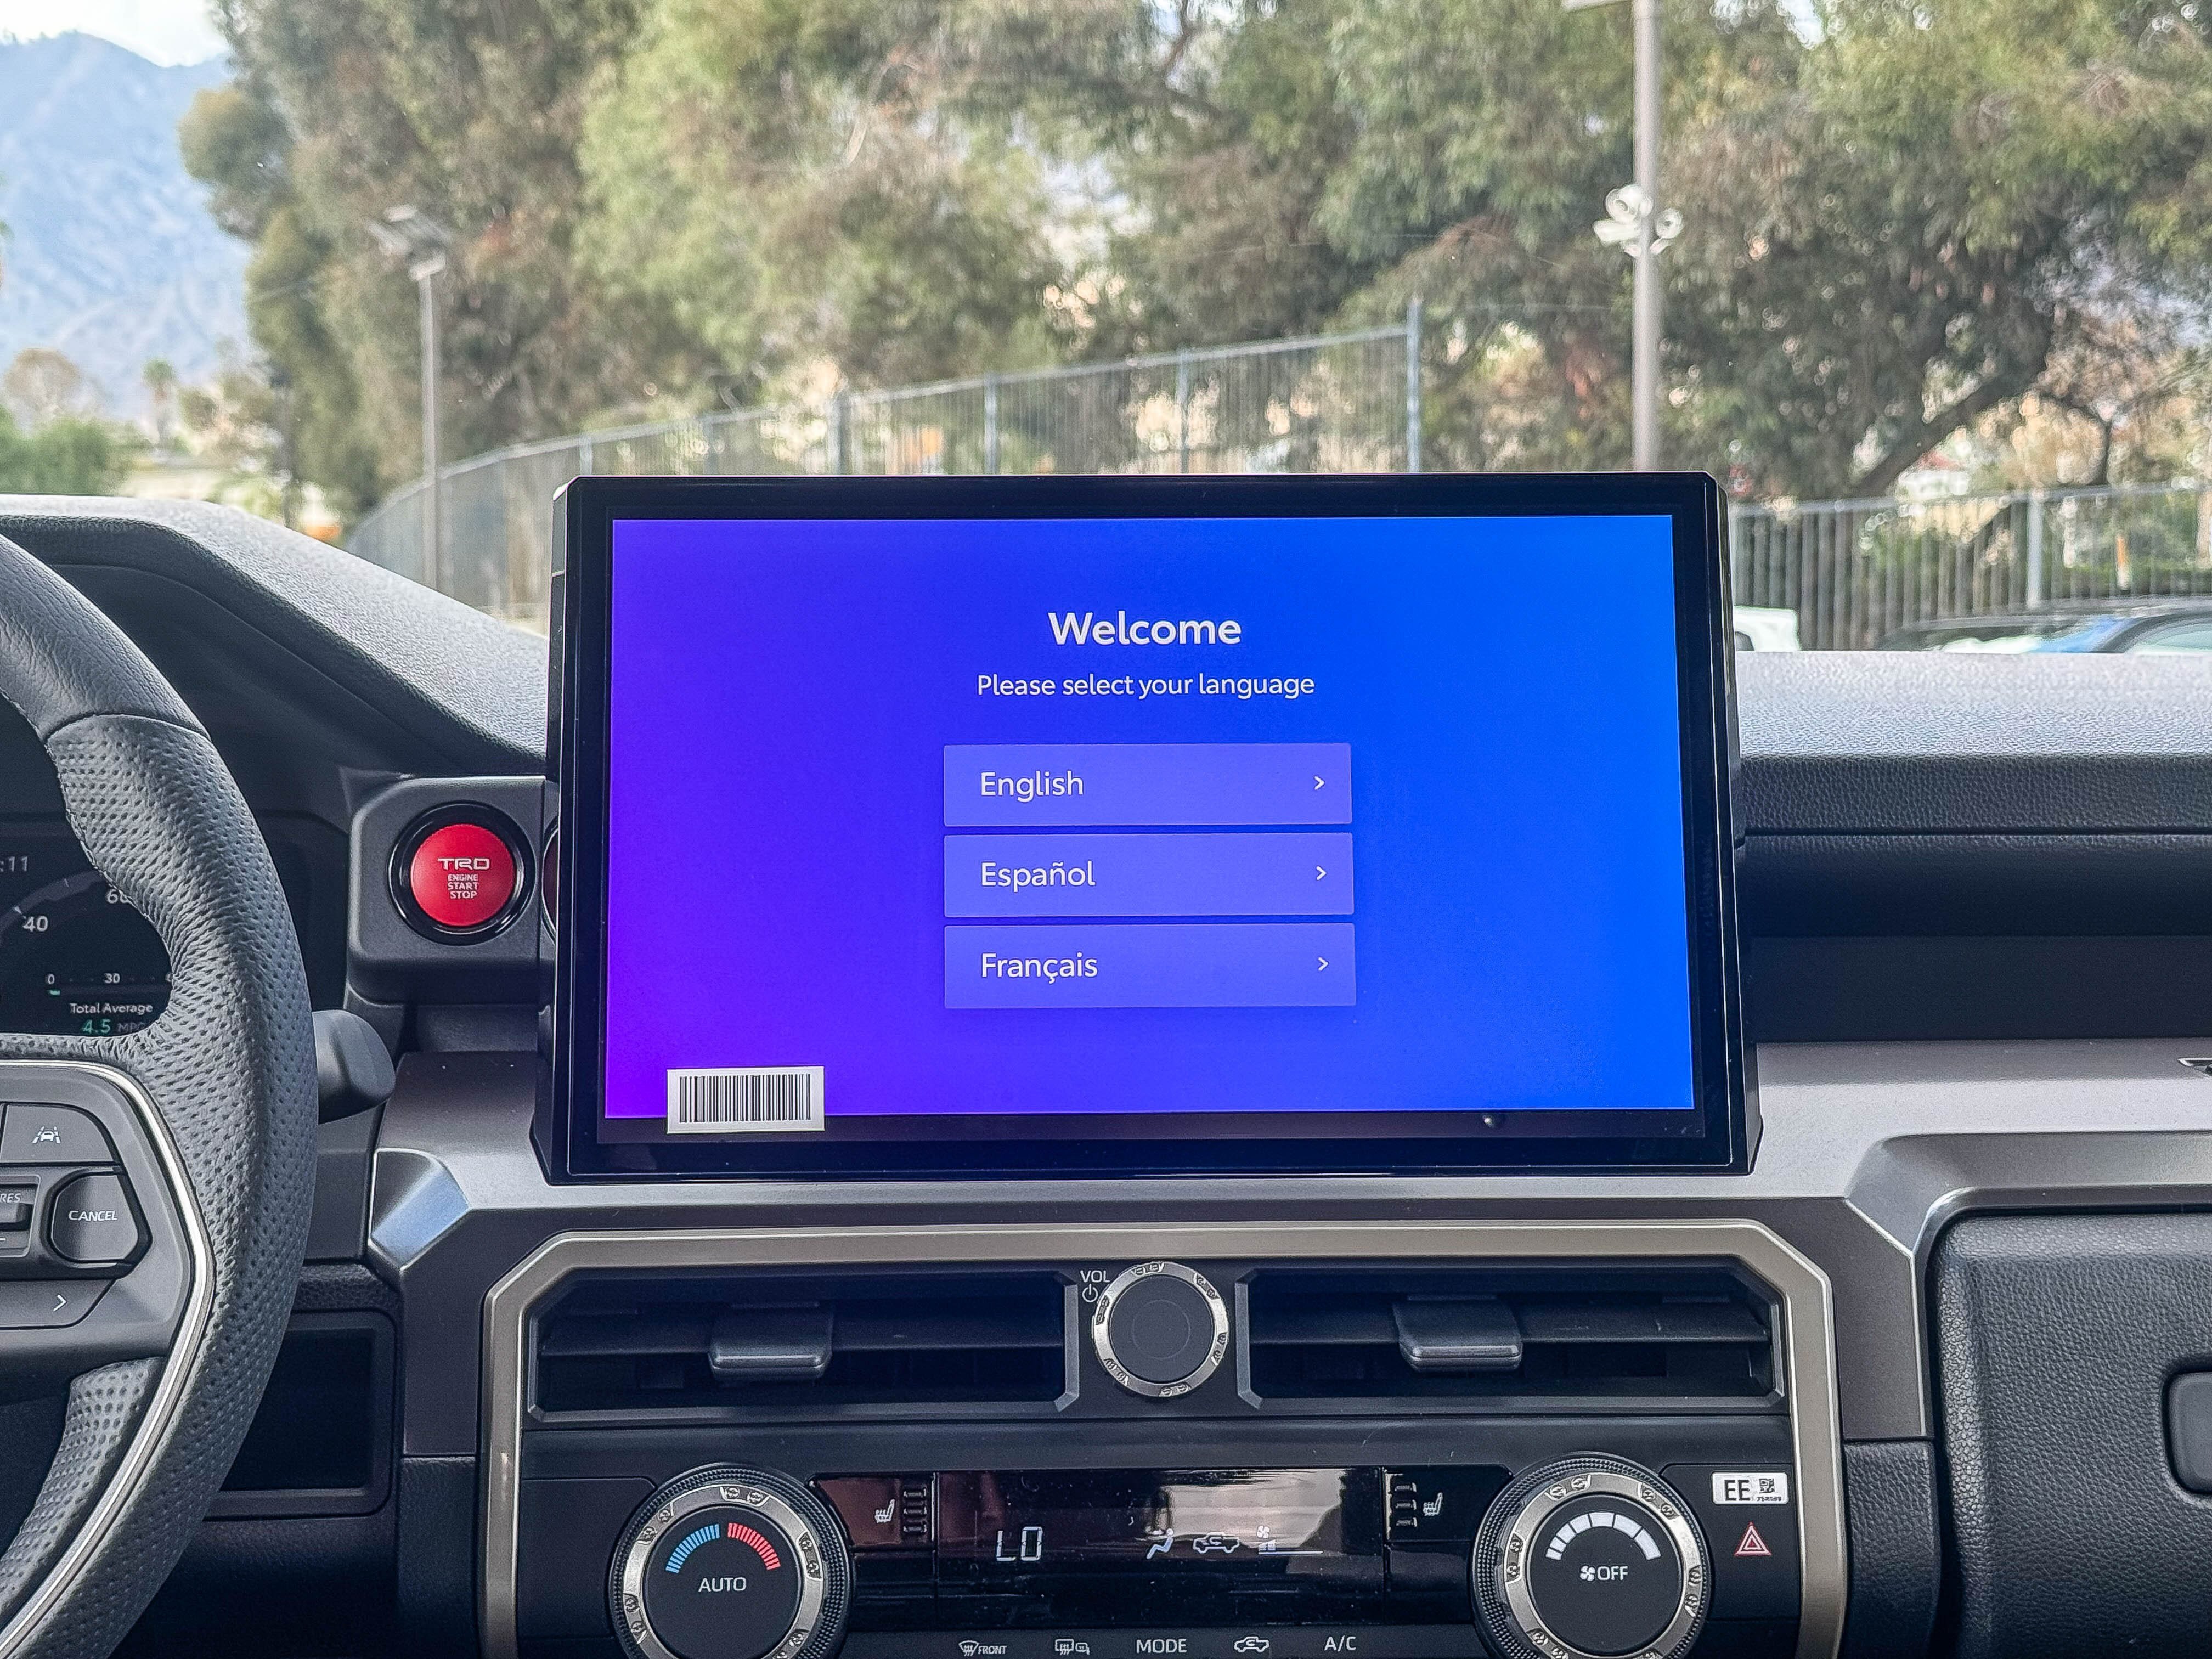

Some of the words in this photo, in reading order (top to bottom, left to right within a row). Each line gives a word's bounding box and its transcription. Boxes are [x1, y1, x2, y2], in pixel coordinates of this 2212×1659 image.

[1048, 610, 1242, 646] Welcome
[978, 674, 1056, 696] Please
[1063, 674, 1134, 696] select
[1138, 679, 1191, 699] your
[1199, 673, 1315, 699] language
[980, 771, 1084, 802] English
[437, 858, 490, 870] TRD
[448, 873, 478, 882] ENGINE
[980, 861, 1096, 893] Español
[448, 882, 479, 890] START
[450, 890, 478, 899] STOP
[22, 916, 48, 932] 40
[980, 952, 1098, 984] Français
[48, 974, 55, 985] 0
[104, 973, 120, 984] 30
[70, 1002, 100, 1014] Total
[103, 1003, 153, 1015] Average
[82, 1019, 110, 1034] 4.5
[69, 1210, 117, 1221] CANCEL
[1080, 1270, 1110, 1283] VOL
[1724, 1479, 1751, 1501] EE
[1597, 1565, 1628, 1581] OFF
[698, 1577, 747, 1593] AUTO
[978, 1645, 1007, 1655] FRONT
[1136, 1638, 1187, 1654] MODE
[1324, 1635, 1356, 1651] A/C
